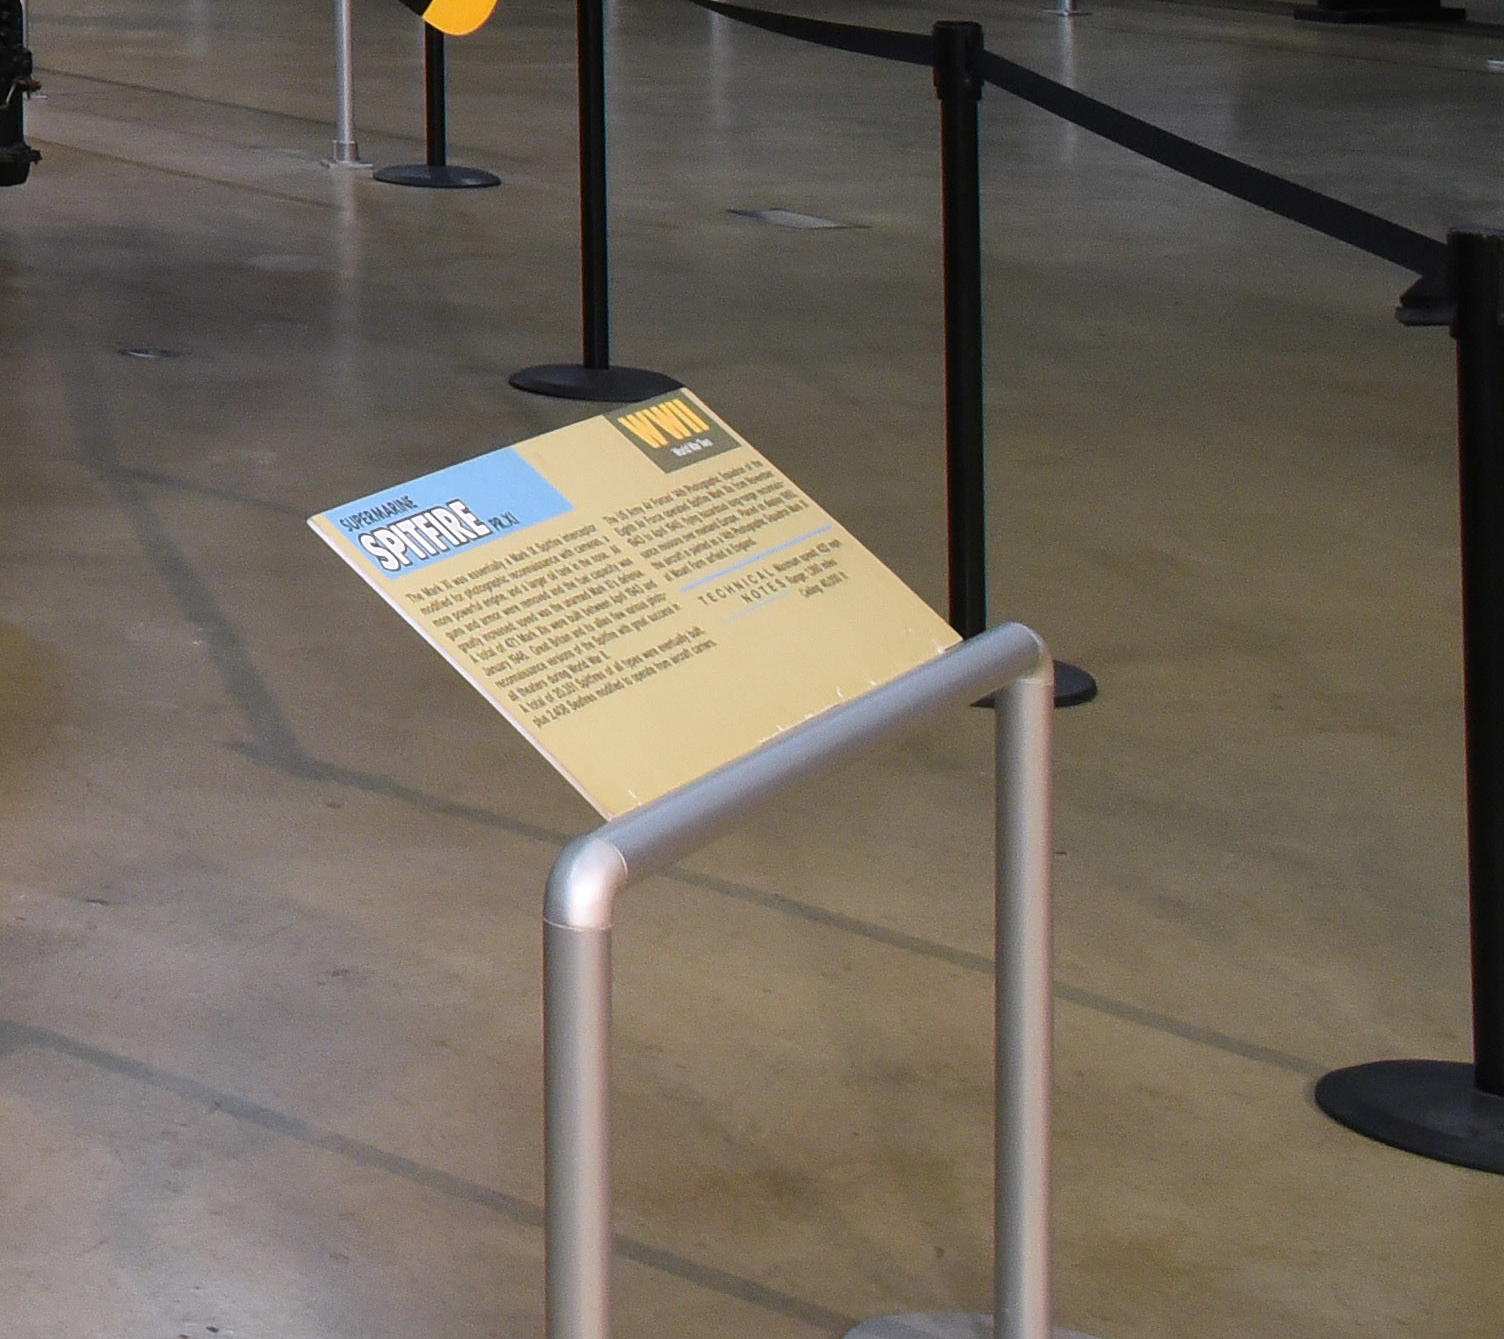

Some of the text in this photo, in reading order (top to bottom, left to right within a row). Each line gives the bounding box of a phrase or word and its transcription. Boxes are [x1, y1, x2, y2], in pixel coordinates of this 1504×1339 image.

[616, 397, 711, 451] WWII
[338, 494, 417, 532] SUPERMARINE
[357, 499, 493, 572] SPITFIRE
[698, 567, 774, 605] TECHNICAL
[740, 578, 787, 604] NOTES
